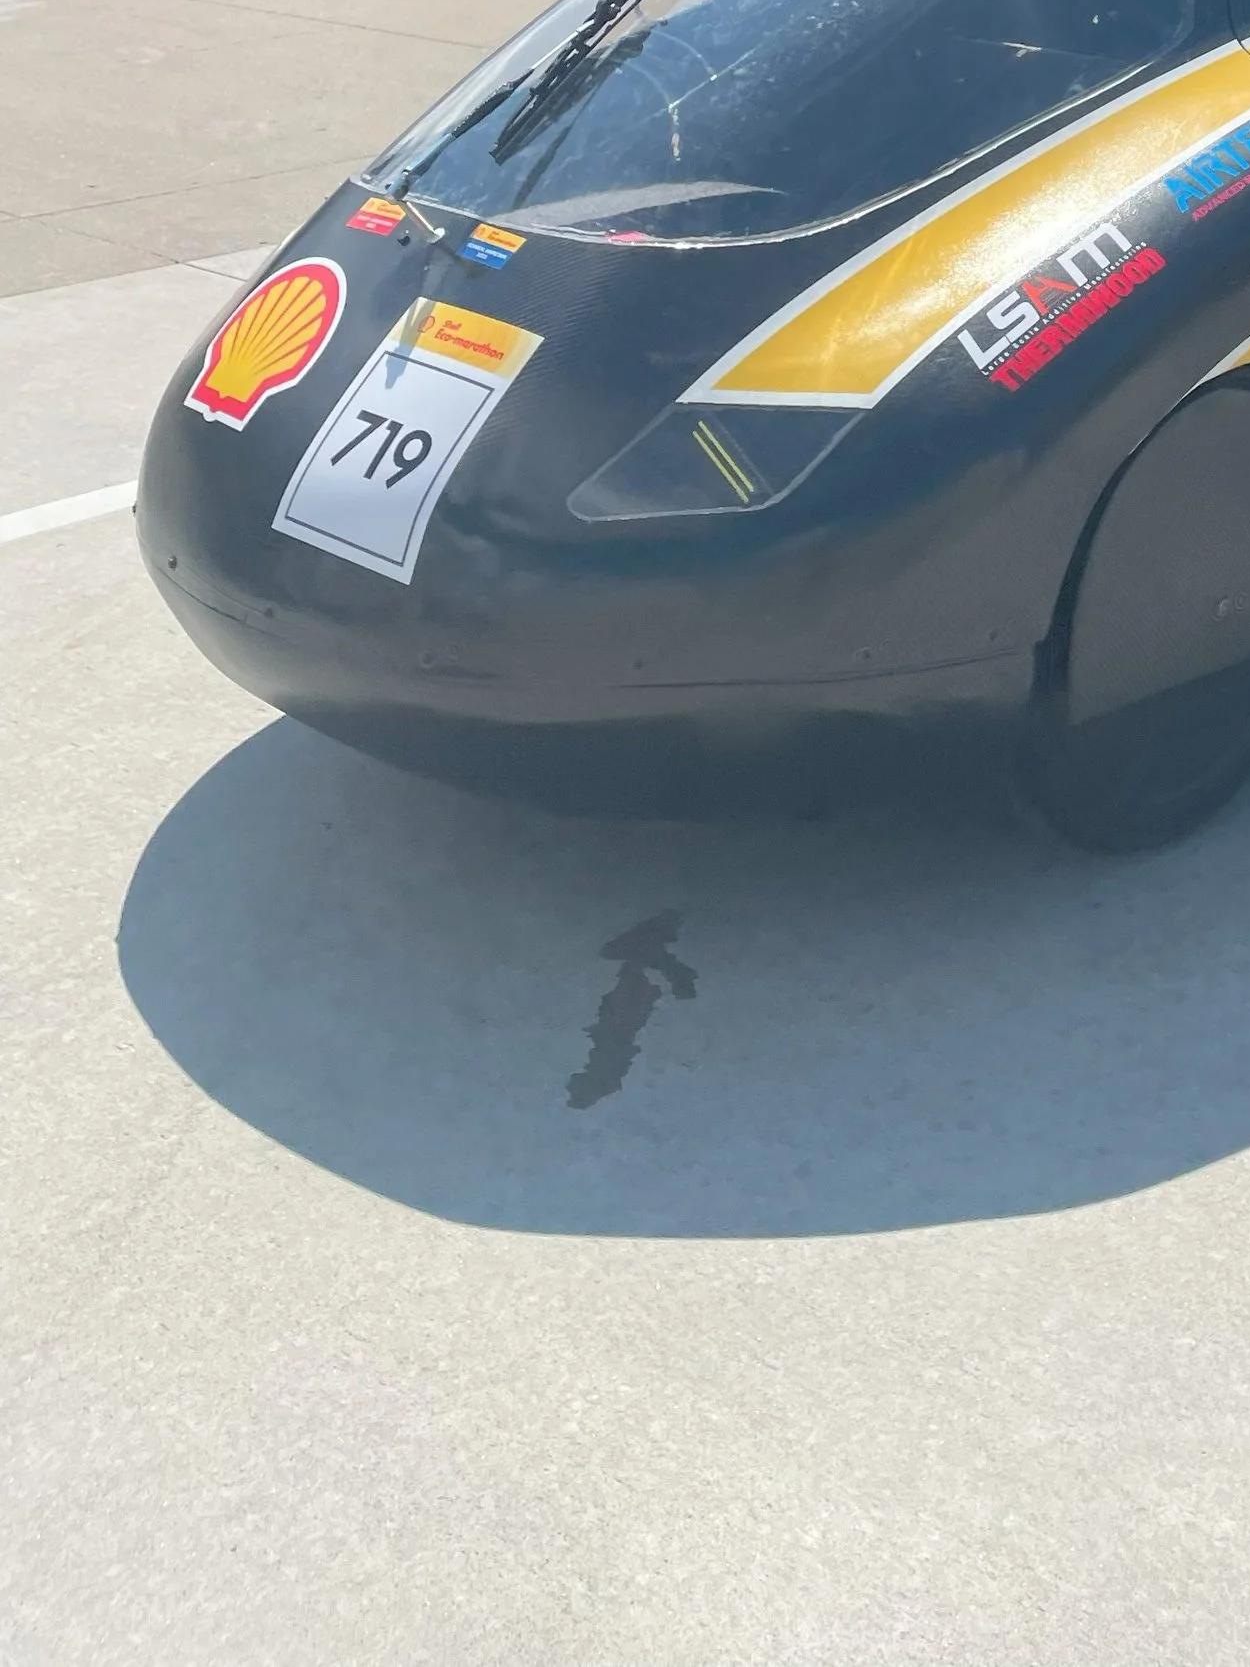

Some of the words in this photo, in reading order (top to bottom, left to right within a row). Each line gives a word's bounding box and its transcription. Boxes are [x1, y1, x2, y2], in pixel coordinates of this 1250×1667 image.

[434, 329, 505, 361] Eco-marathon
[981, 350, 1011, 376] Large
[1011, 325, 1040, 349] Scale
[1042, 291, 1082, 325] Additive
[1083, 240, 1148, 290] Manufacturing
[989, 247, 1167, 393] THERMWOOD
[330, 411, 433, 490] 719
